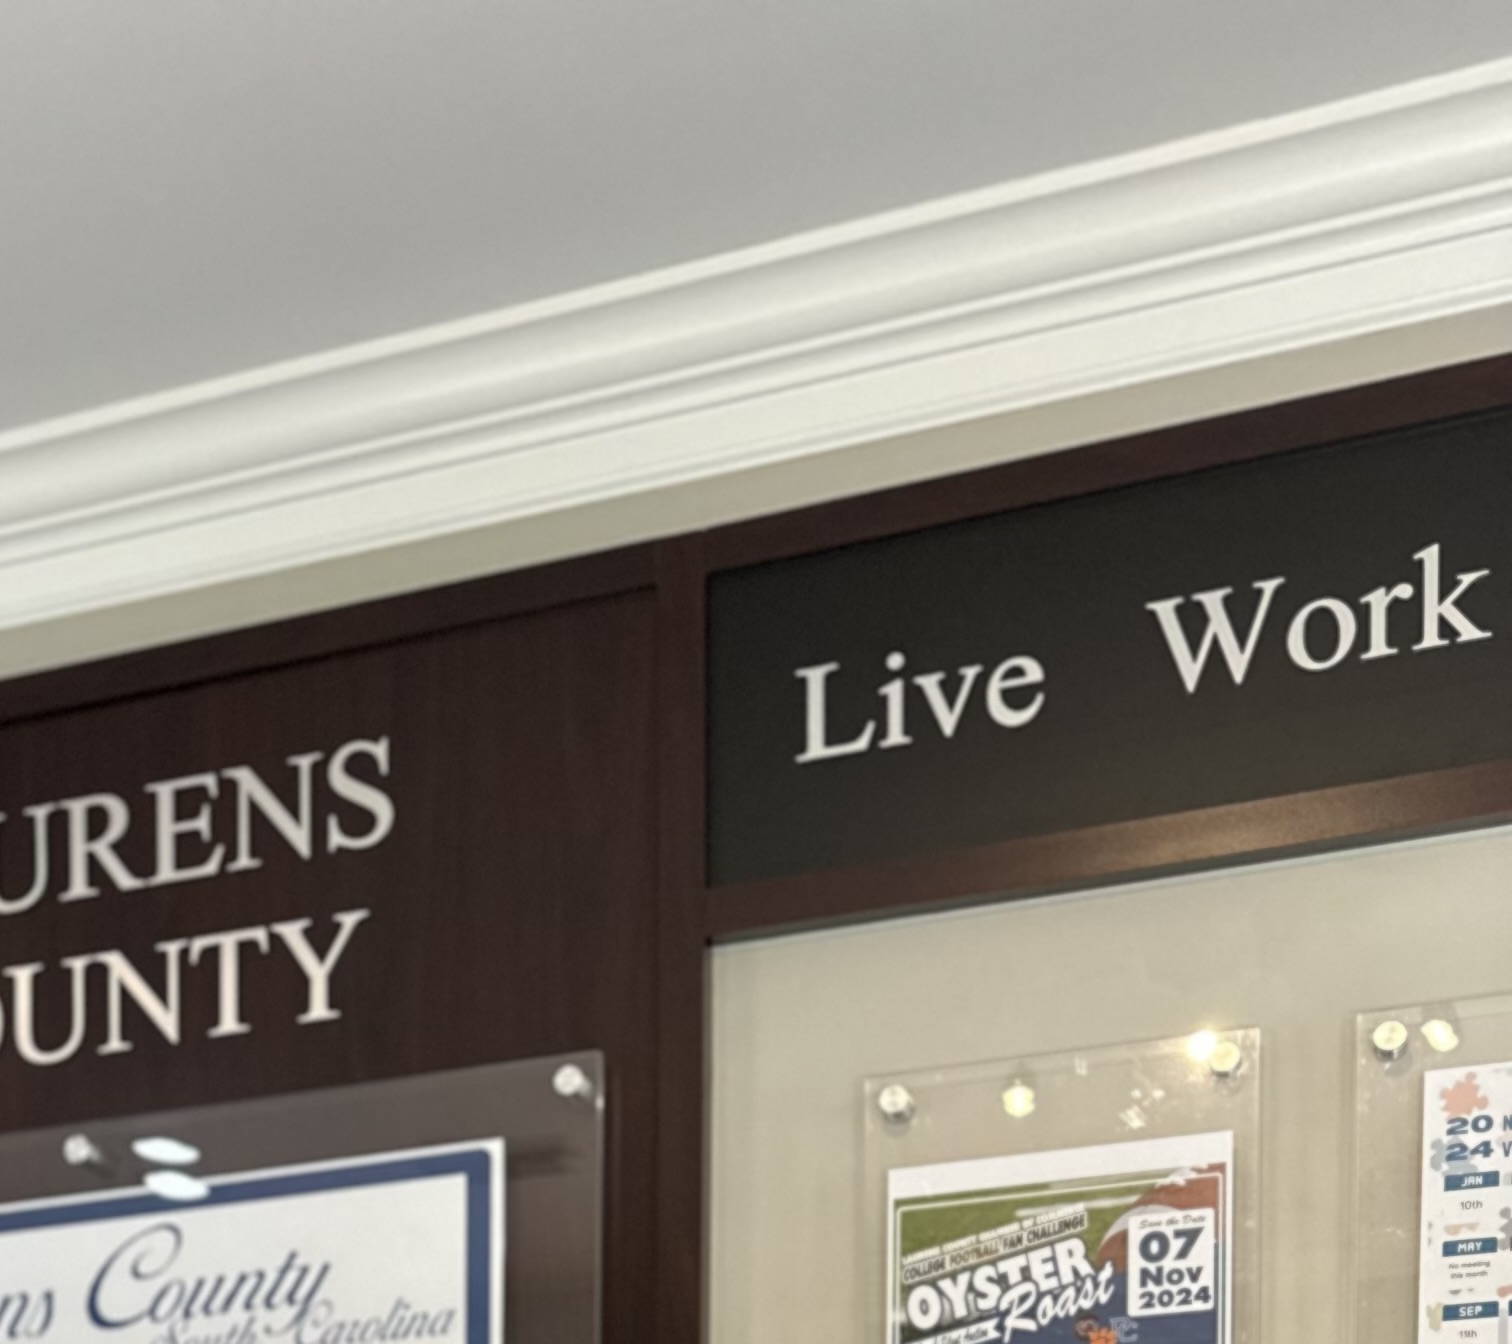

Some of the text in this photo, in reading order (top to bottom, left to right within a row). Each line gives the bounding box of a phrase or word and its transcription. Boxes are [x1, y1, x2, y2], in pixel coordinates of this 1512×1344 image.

[796, 543, 1492, 764] Live Work
[1446, 1115, 1494, 1136] 20
[1446, 1140, 1494, 1162] 24
[1461, 1176, 1483, 1187] JAN
[1460, 1200, 1482, 1210] 10th
[1139, 1227, 1205, 1263] 07
[1457, 1241, 1482, 1253] MAY
[86, 1223, 332, 1336] County
[903, 1257, 947, 1281] COLLEGE
[1139, 1265, 1204, 1288] Nov
[907, 1237, 1096, 1331] OYSTER
[999, 1261, 1115, 1344] Roast
[1138, 1285, 1211, 1309] 2024
[1459, 1306, 1482, 1317] SEP
